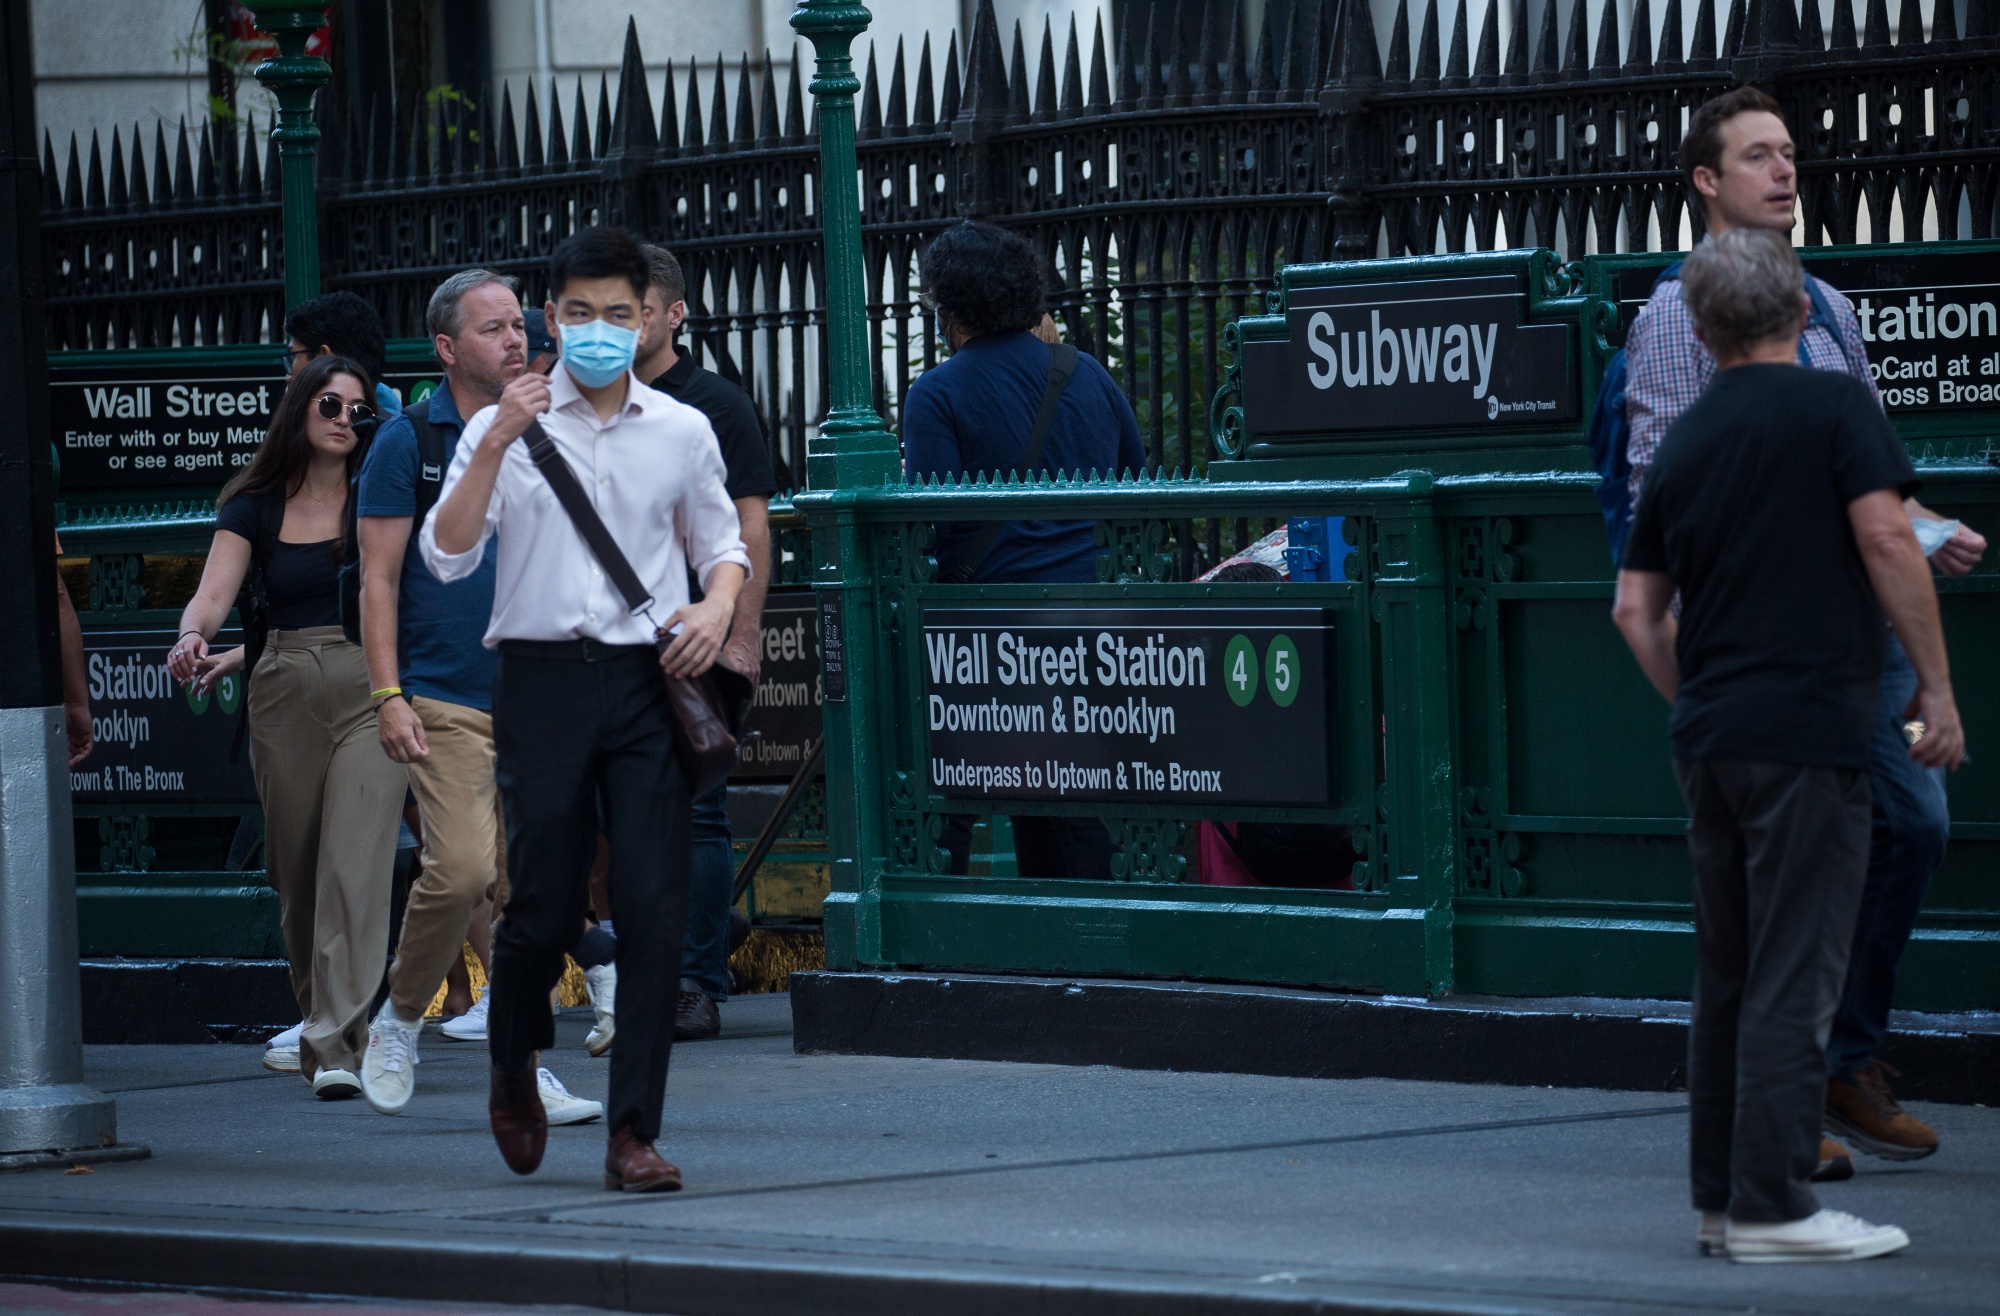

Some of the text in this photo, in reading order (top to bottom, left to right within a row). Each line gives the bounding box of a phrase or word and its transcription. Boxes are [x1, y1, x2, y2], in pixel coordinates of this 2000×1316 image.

[1849, 293, 1997, 342] tation
[1307, 310, 1498, 400] Subway
[1947, 355, 1970, 377] at
[84, 385, 270, 418] Wall Street
[1500, 400, 1556, 412] New York City Transit
[65, 427, 269, 450] Enter with or buy Metr
[108, 455, 128, 469] or
[134, 455, 167, 469] see
[174, 451, 224, 471] agent
[824, 604, 837, 613] WALL
[827, 663, 841, 672] BKLYN
[926, 632, 1290, 692] Wall Street Station 4 5
[88, 653, 172, 700] Station
[929, 695, 1176, 743] Downtown & Brooklyn
[757, 740, 799, 765] Uptown
[104, 765, 114, 791] &
[116, 765, 142, 791] The
[145, 765, 185, 791] Bronx
[932, 758, 1222, 795] Underpass to Uptown & The Bronx
